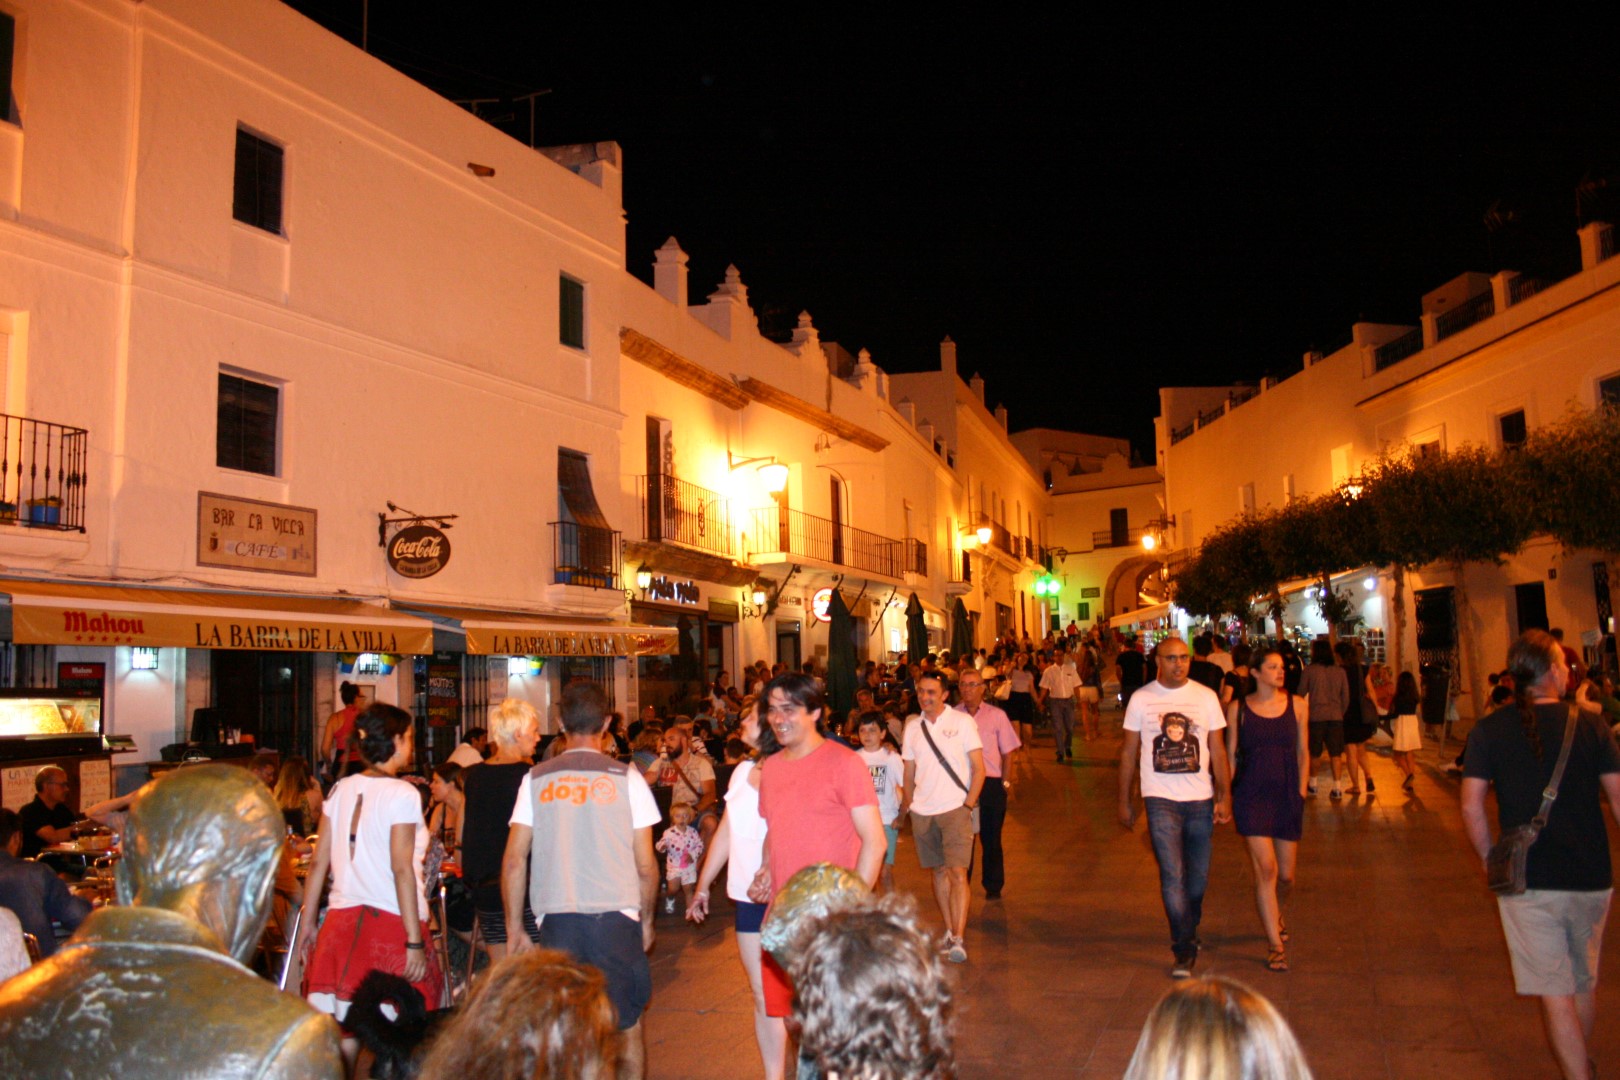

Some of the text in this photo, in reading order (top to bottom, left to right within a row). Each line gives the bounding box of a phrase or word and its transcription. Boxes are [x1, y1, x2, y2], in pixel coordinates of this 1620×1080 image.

[213, 507, 305, 536] BAR LA VILLA
[235, 541, 279, 559] CAFÉ
[63, 611, 144, 634] Mahou
[195, 623, 397, 652] LA BARRA DE LA VILLA
[493, 636, 510, 653] LA
[514, 636, 552, 654] BARRA
[555, 637, 570, 655] DE
[572, 638, 586, 655] LA
[539, 781, 588, 806] dog
